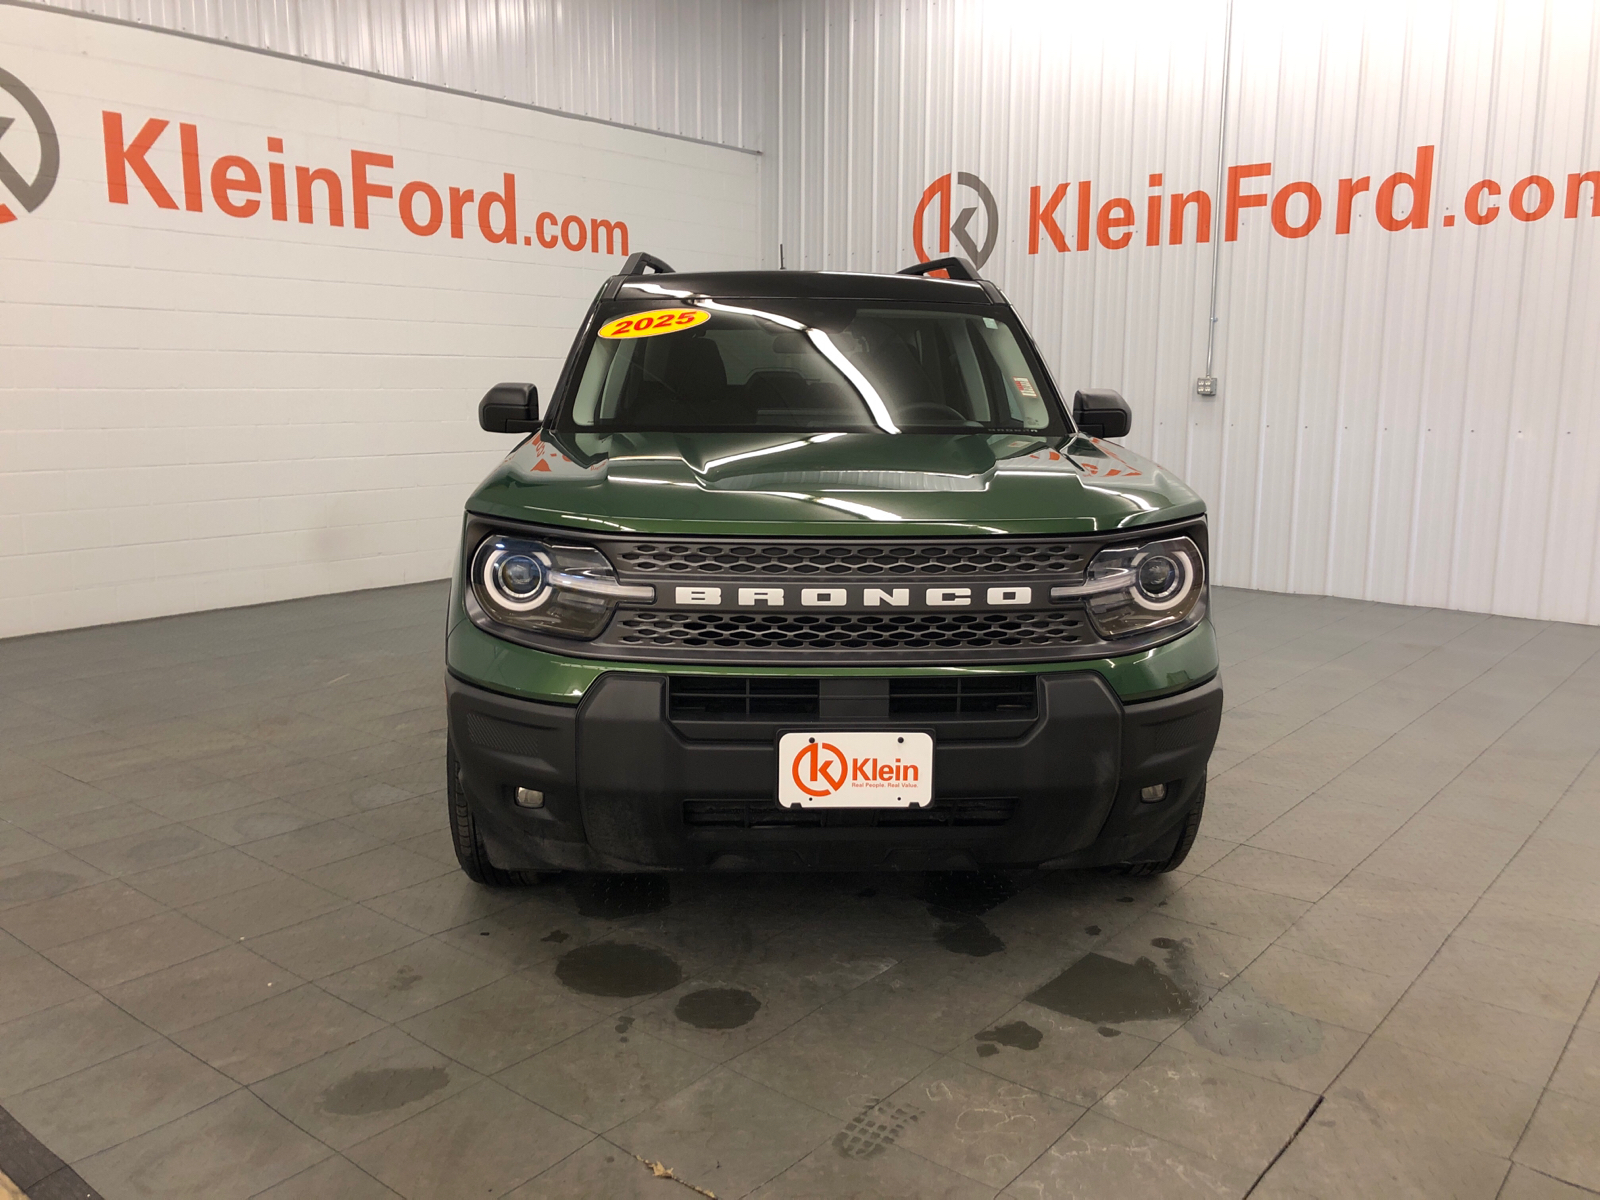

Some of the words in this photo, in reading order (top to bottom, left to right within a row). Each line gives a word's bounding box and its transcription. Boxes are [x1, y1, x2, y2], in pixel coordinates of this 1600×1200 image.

[102, 110, 629, 257] KleinFord.com
[610, 310, 698, 336] 2025
[674, 586, 1032, 607] BRONCO
[851, 758, 919, 782] Klein
